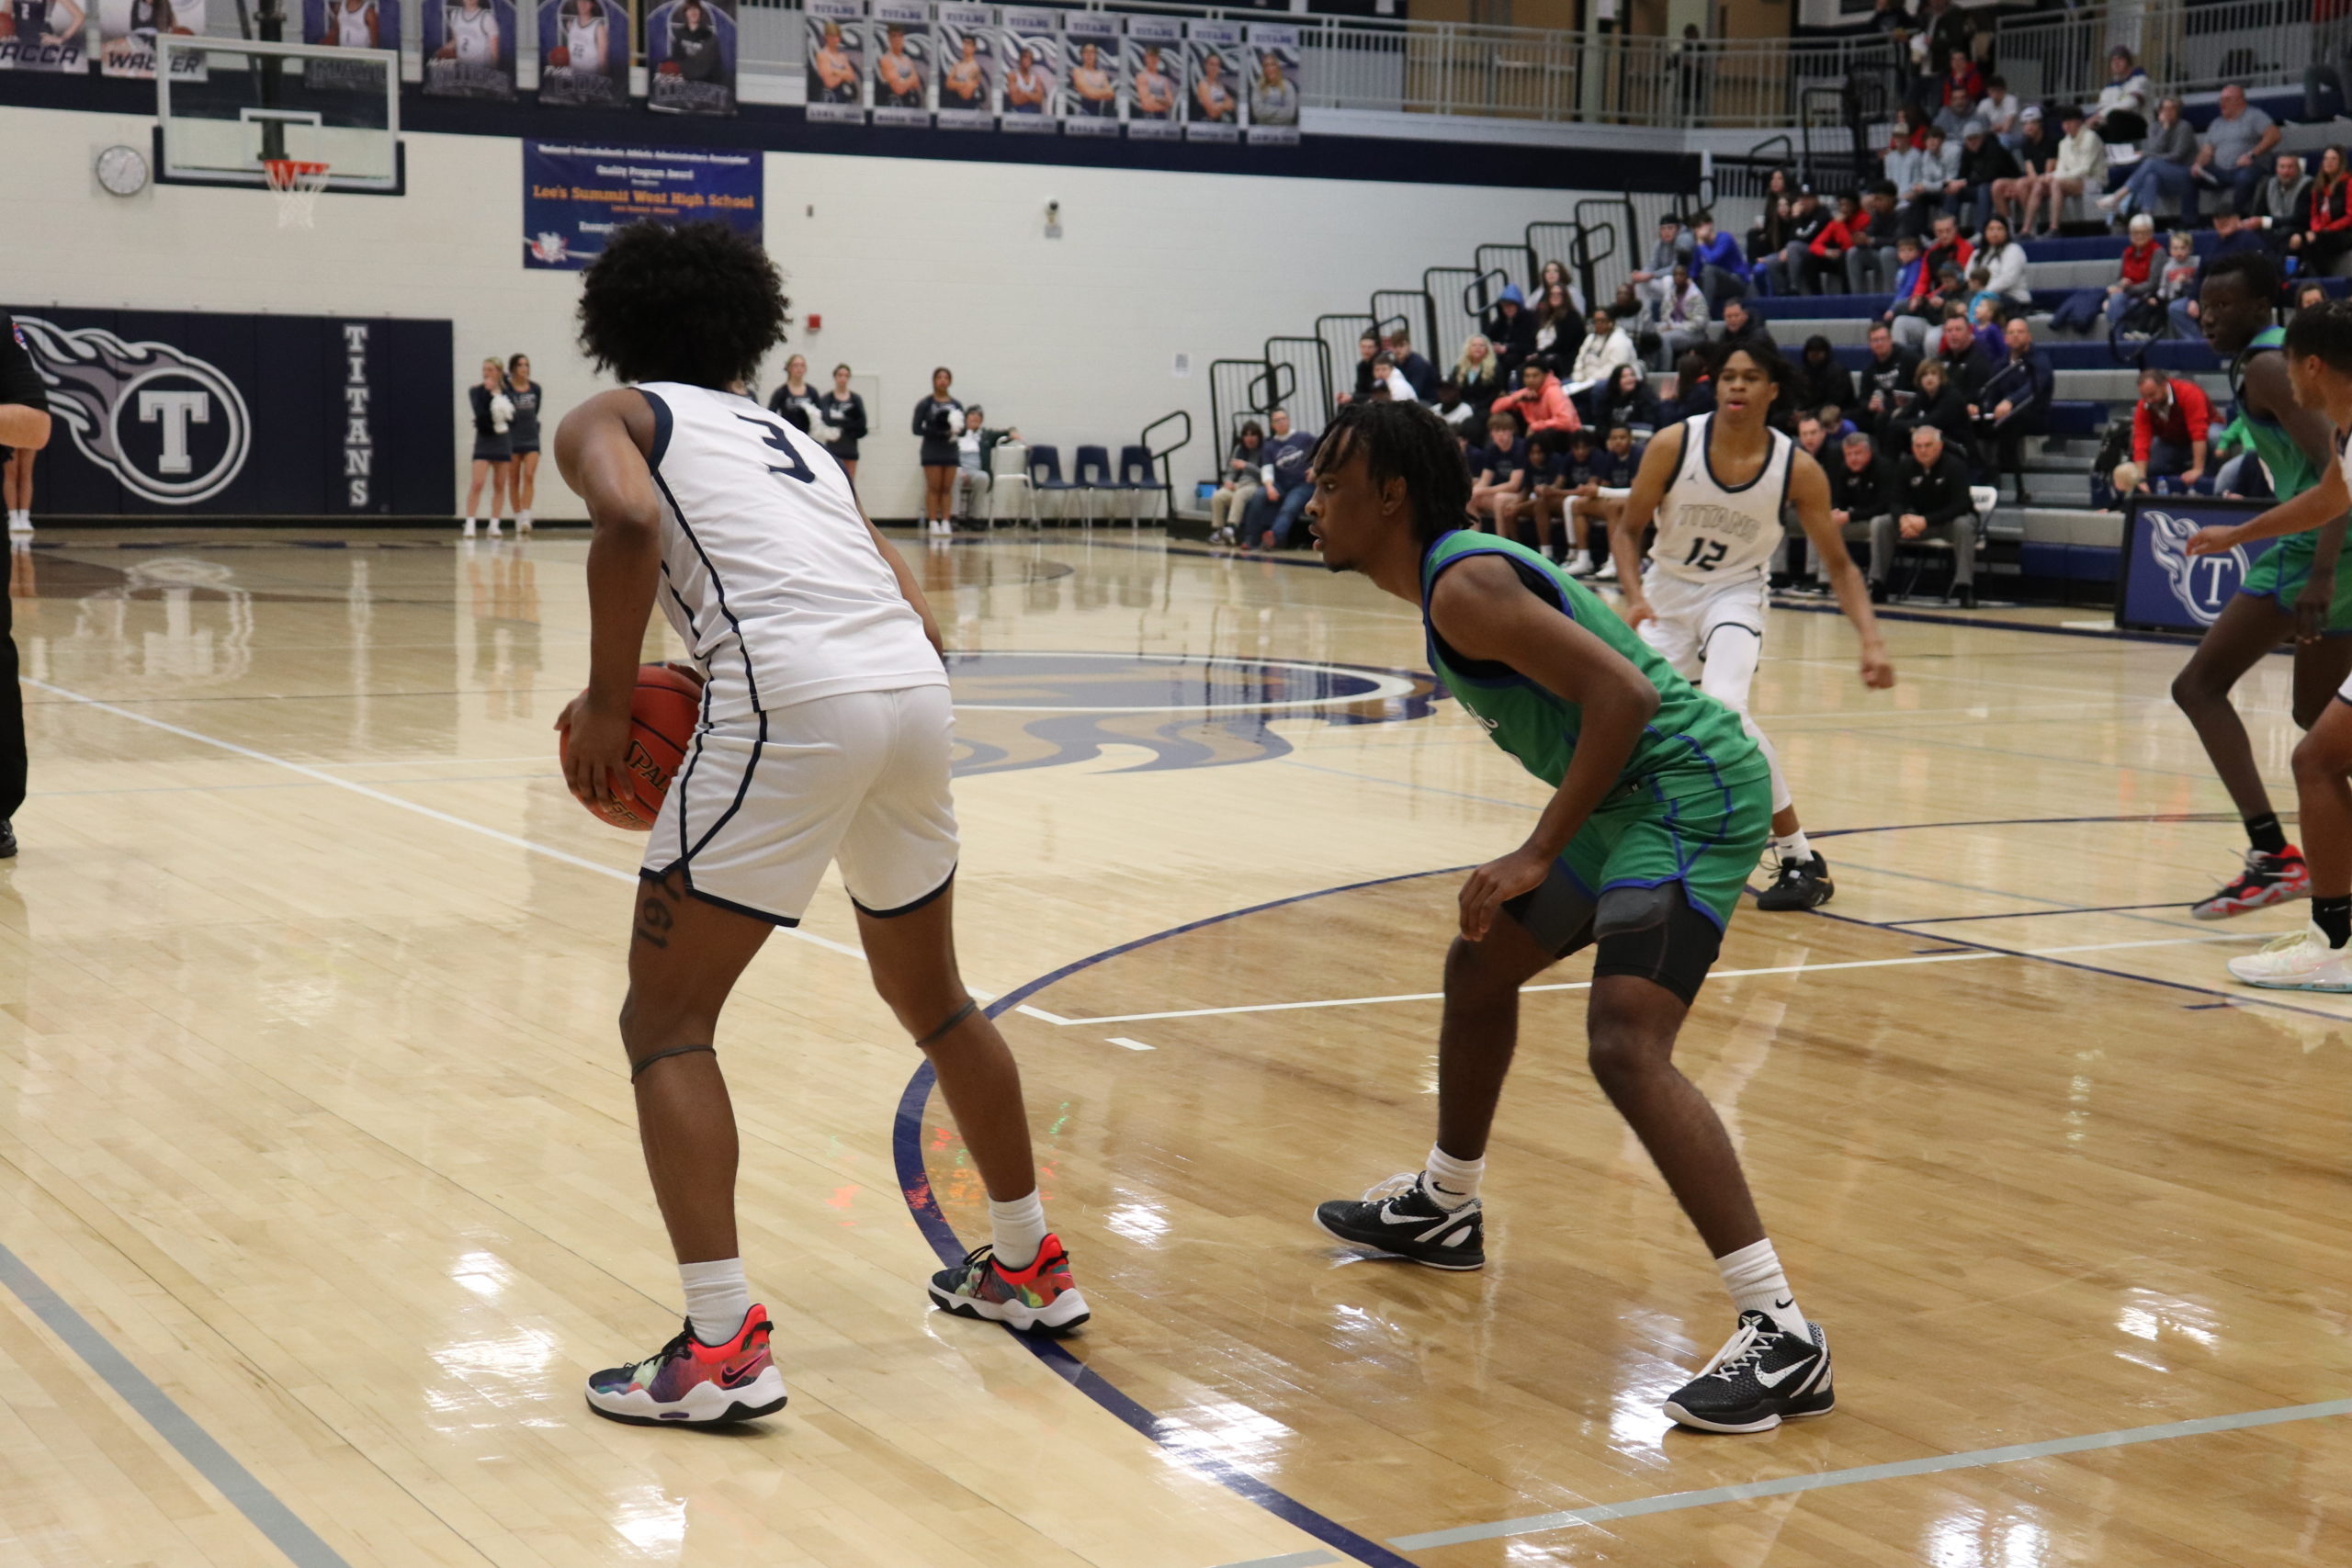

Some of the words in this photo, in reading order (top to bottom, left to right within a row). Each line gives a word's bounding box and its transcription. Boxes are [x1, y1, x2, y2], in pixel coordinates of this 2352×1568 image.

[108, 51, 200, 73] WALER
[596, 164, 628, 177] Quality
[628, 165, 665, 179] Program
[533, 185, 568, 199] Lee's
[571, 186, 629, 203] Summit
[633, 190, 667, 204] West
[671, 192, 705, 208] High
[708, 195, 755, 209] School
[139, 390, 210, 474] T
[344, 324, 373, 506] TITANS
[730, 410, 816, 484] 3
[1678, 504, 1762, 544] TITANS
[1684, 536, 1728, 571] 12
[2201, 558, 2233, 605] T
[624, 739, 668, 795] SPAL
